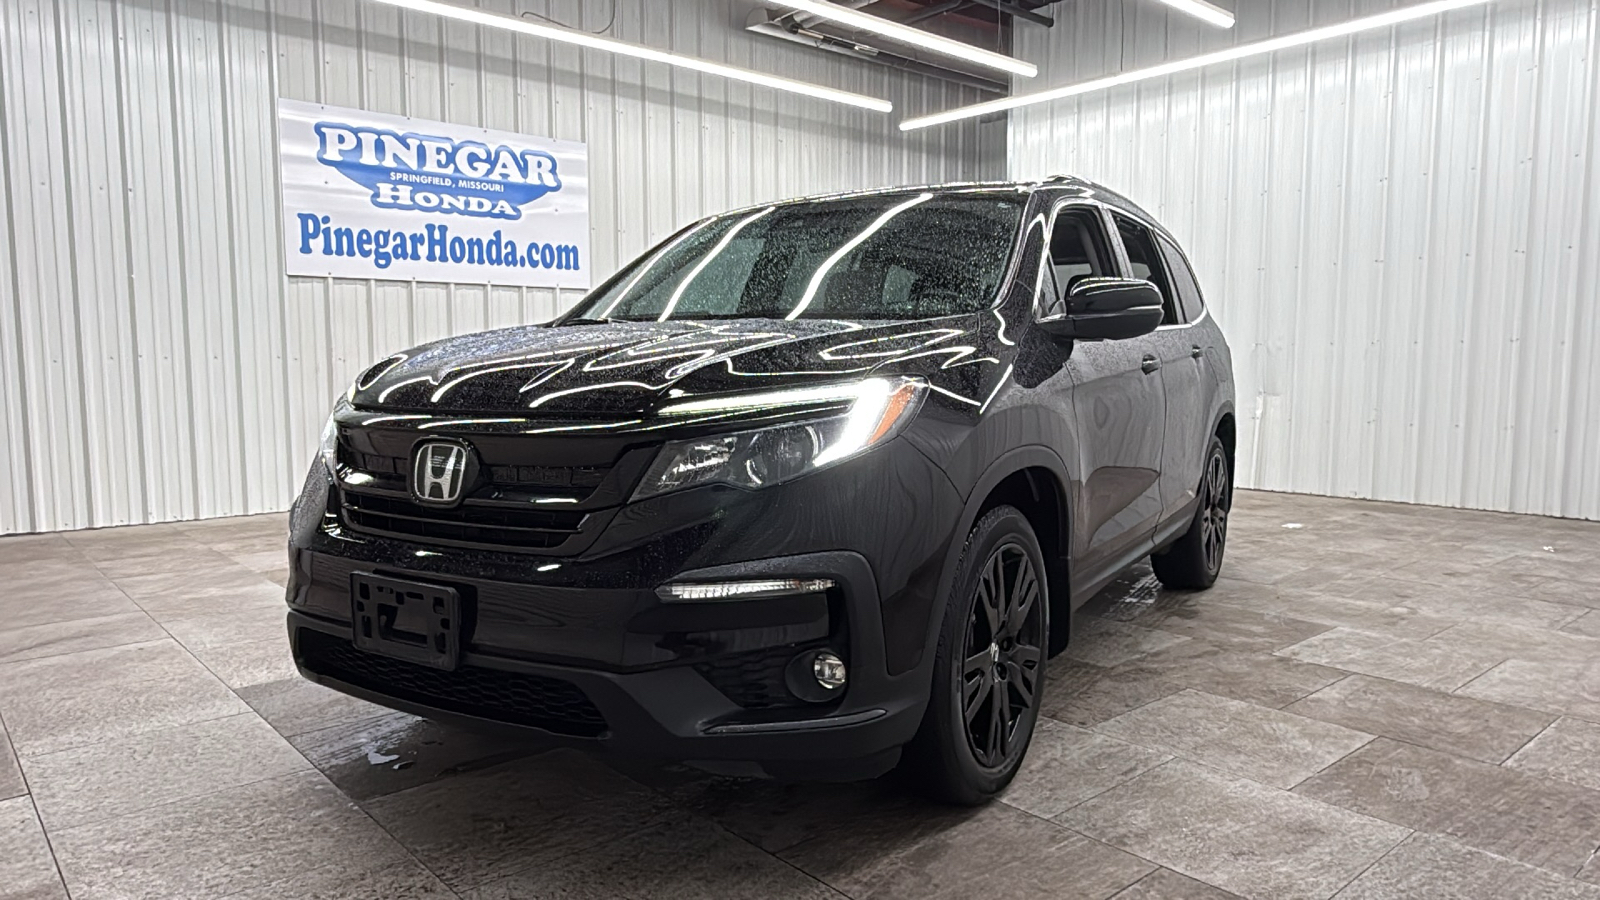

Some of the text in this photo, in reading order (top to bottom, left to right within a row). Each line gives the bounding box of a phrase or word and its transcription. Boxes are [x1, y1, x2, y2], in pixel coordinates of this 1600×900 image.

[320, 126, 557, 187] PINEGAR
[376, 183, 518, 216] HONDA
[390, 171, 504, 192] SPRINGFIELD, MISSOURI
[297, 212, 580, 270] PinegarHonda.com
